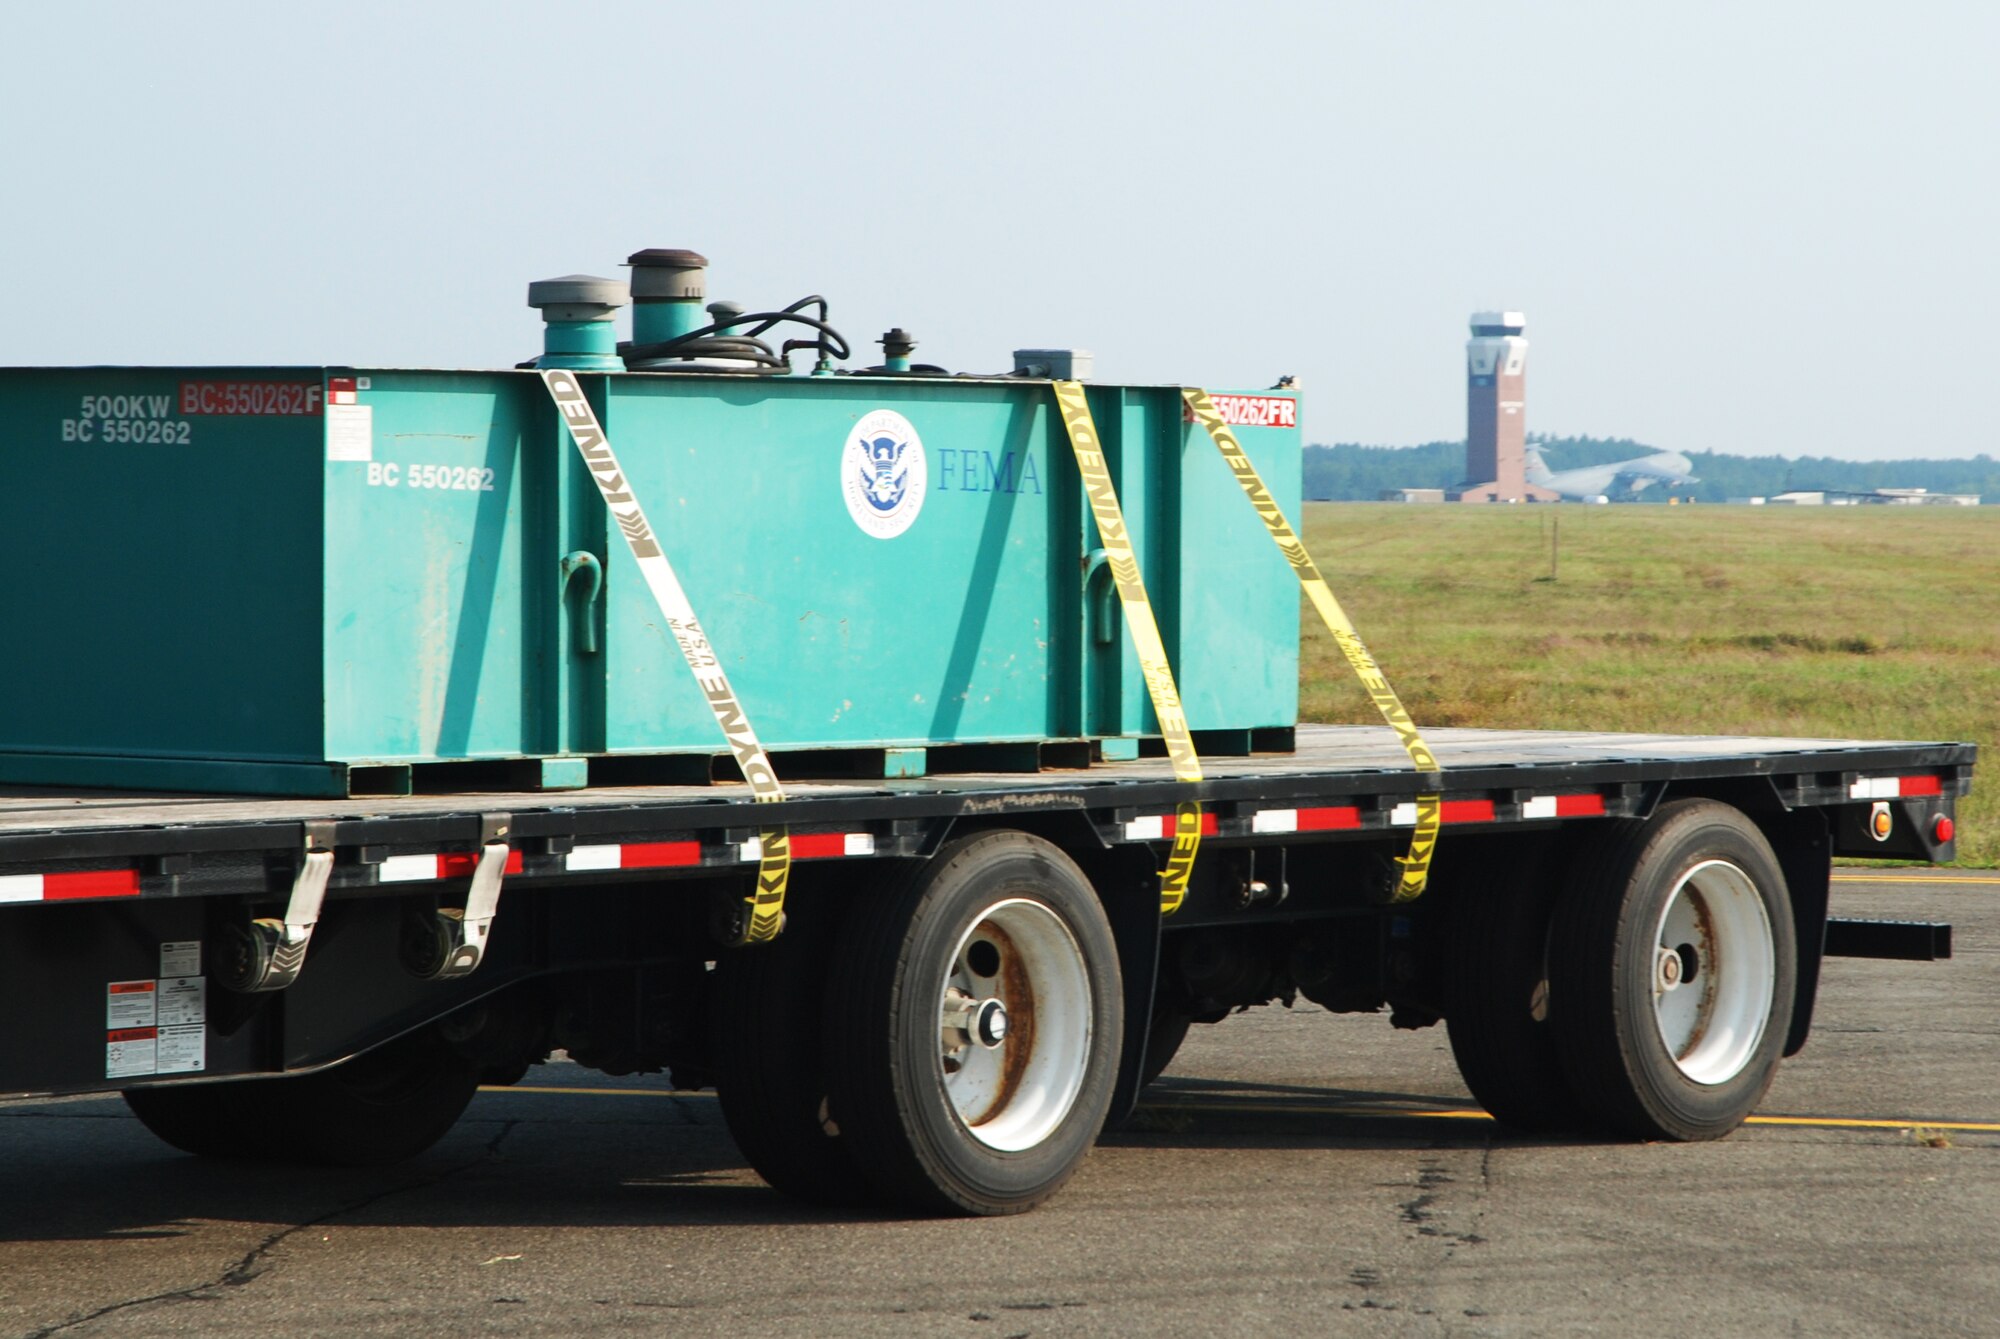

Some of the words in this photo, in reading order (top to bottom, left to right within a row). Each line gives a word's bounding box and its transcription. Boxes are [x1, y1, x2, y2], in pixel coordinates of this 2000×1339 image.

[81, 395, 171, 419] 500KW
[62, 418, 93, 442] BC
[102, 419, 191, 444] 550262
[367, 462, 400, 487] BC
[407, 464, 495, 491] 550262
[937, 448, 1042, 494] FEMA
[667, 618, 682, 630] IN
[678, 634, 702, 668] MADE
